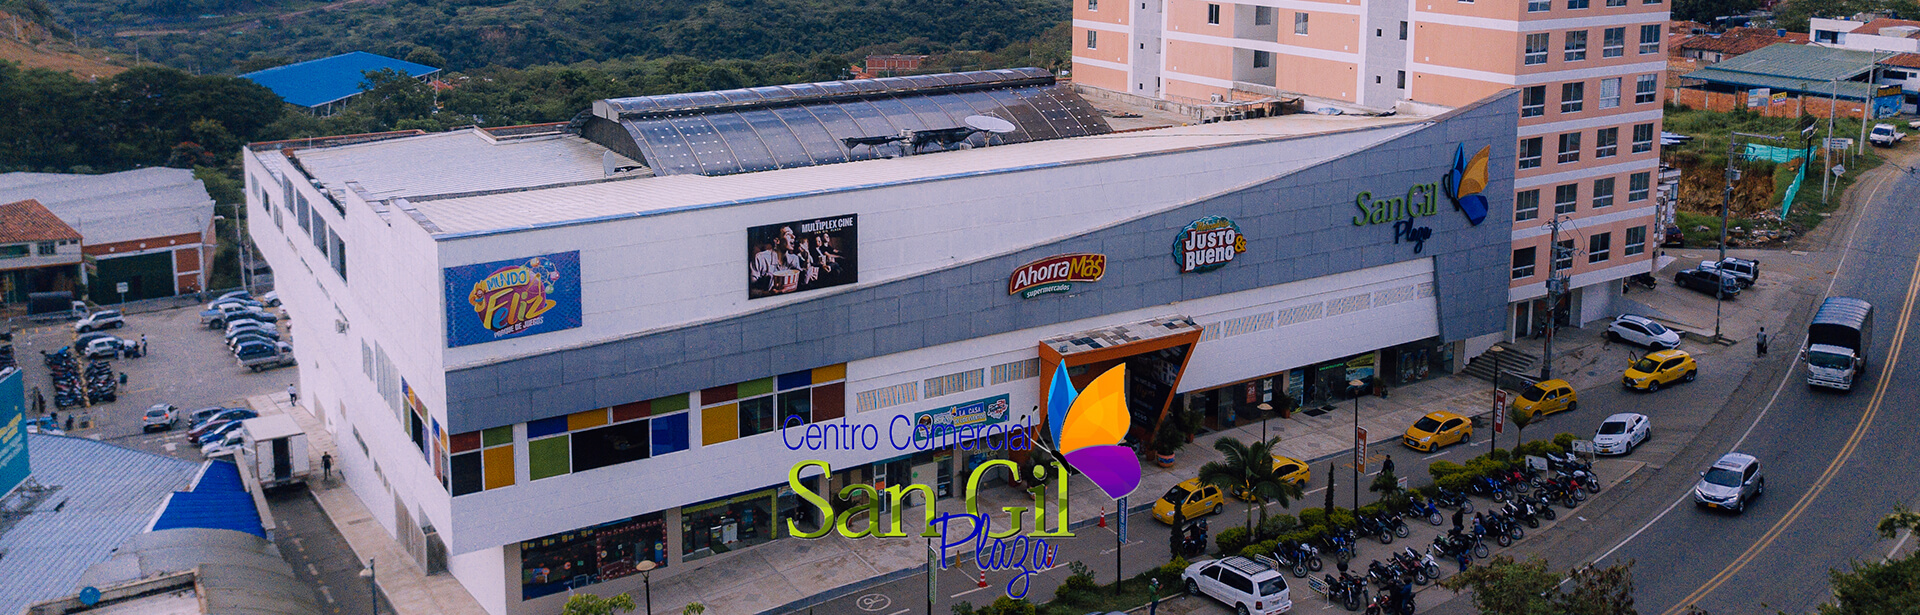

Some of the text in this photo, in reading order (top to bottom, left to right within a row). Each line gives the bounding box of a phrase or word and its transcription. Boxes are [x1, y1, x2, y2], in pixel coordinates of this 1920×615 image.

[801, 216, 854, 234] MULTIPLEX CINE
[1234, 235, 1247, 253] &
[486, 270, 527, 291] MUNDO
[1026, 283, 1070, 298] supermercados
[483, 288, 557, 330] Feliz
[968, 406, 981, 415] CASA
